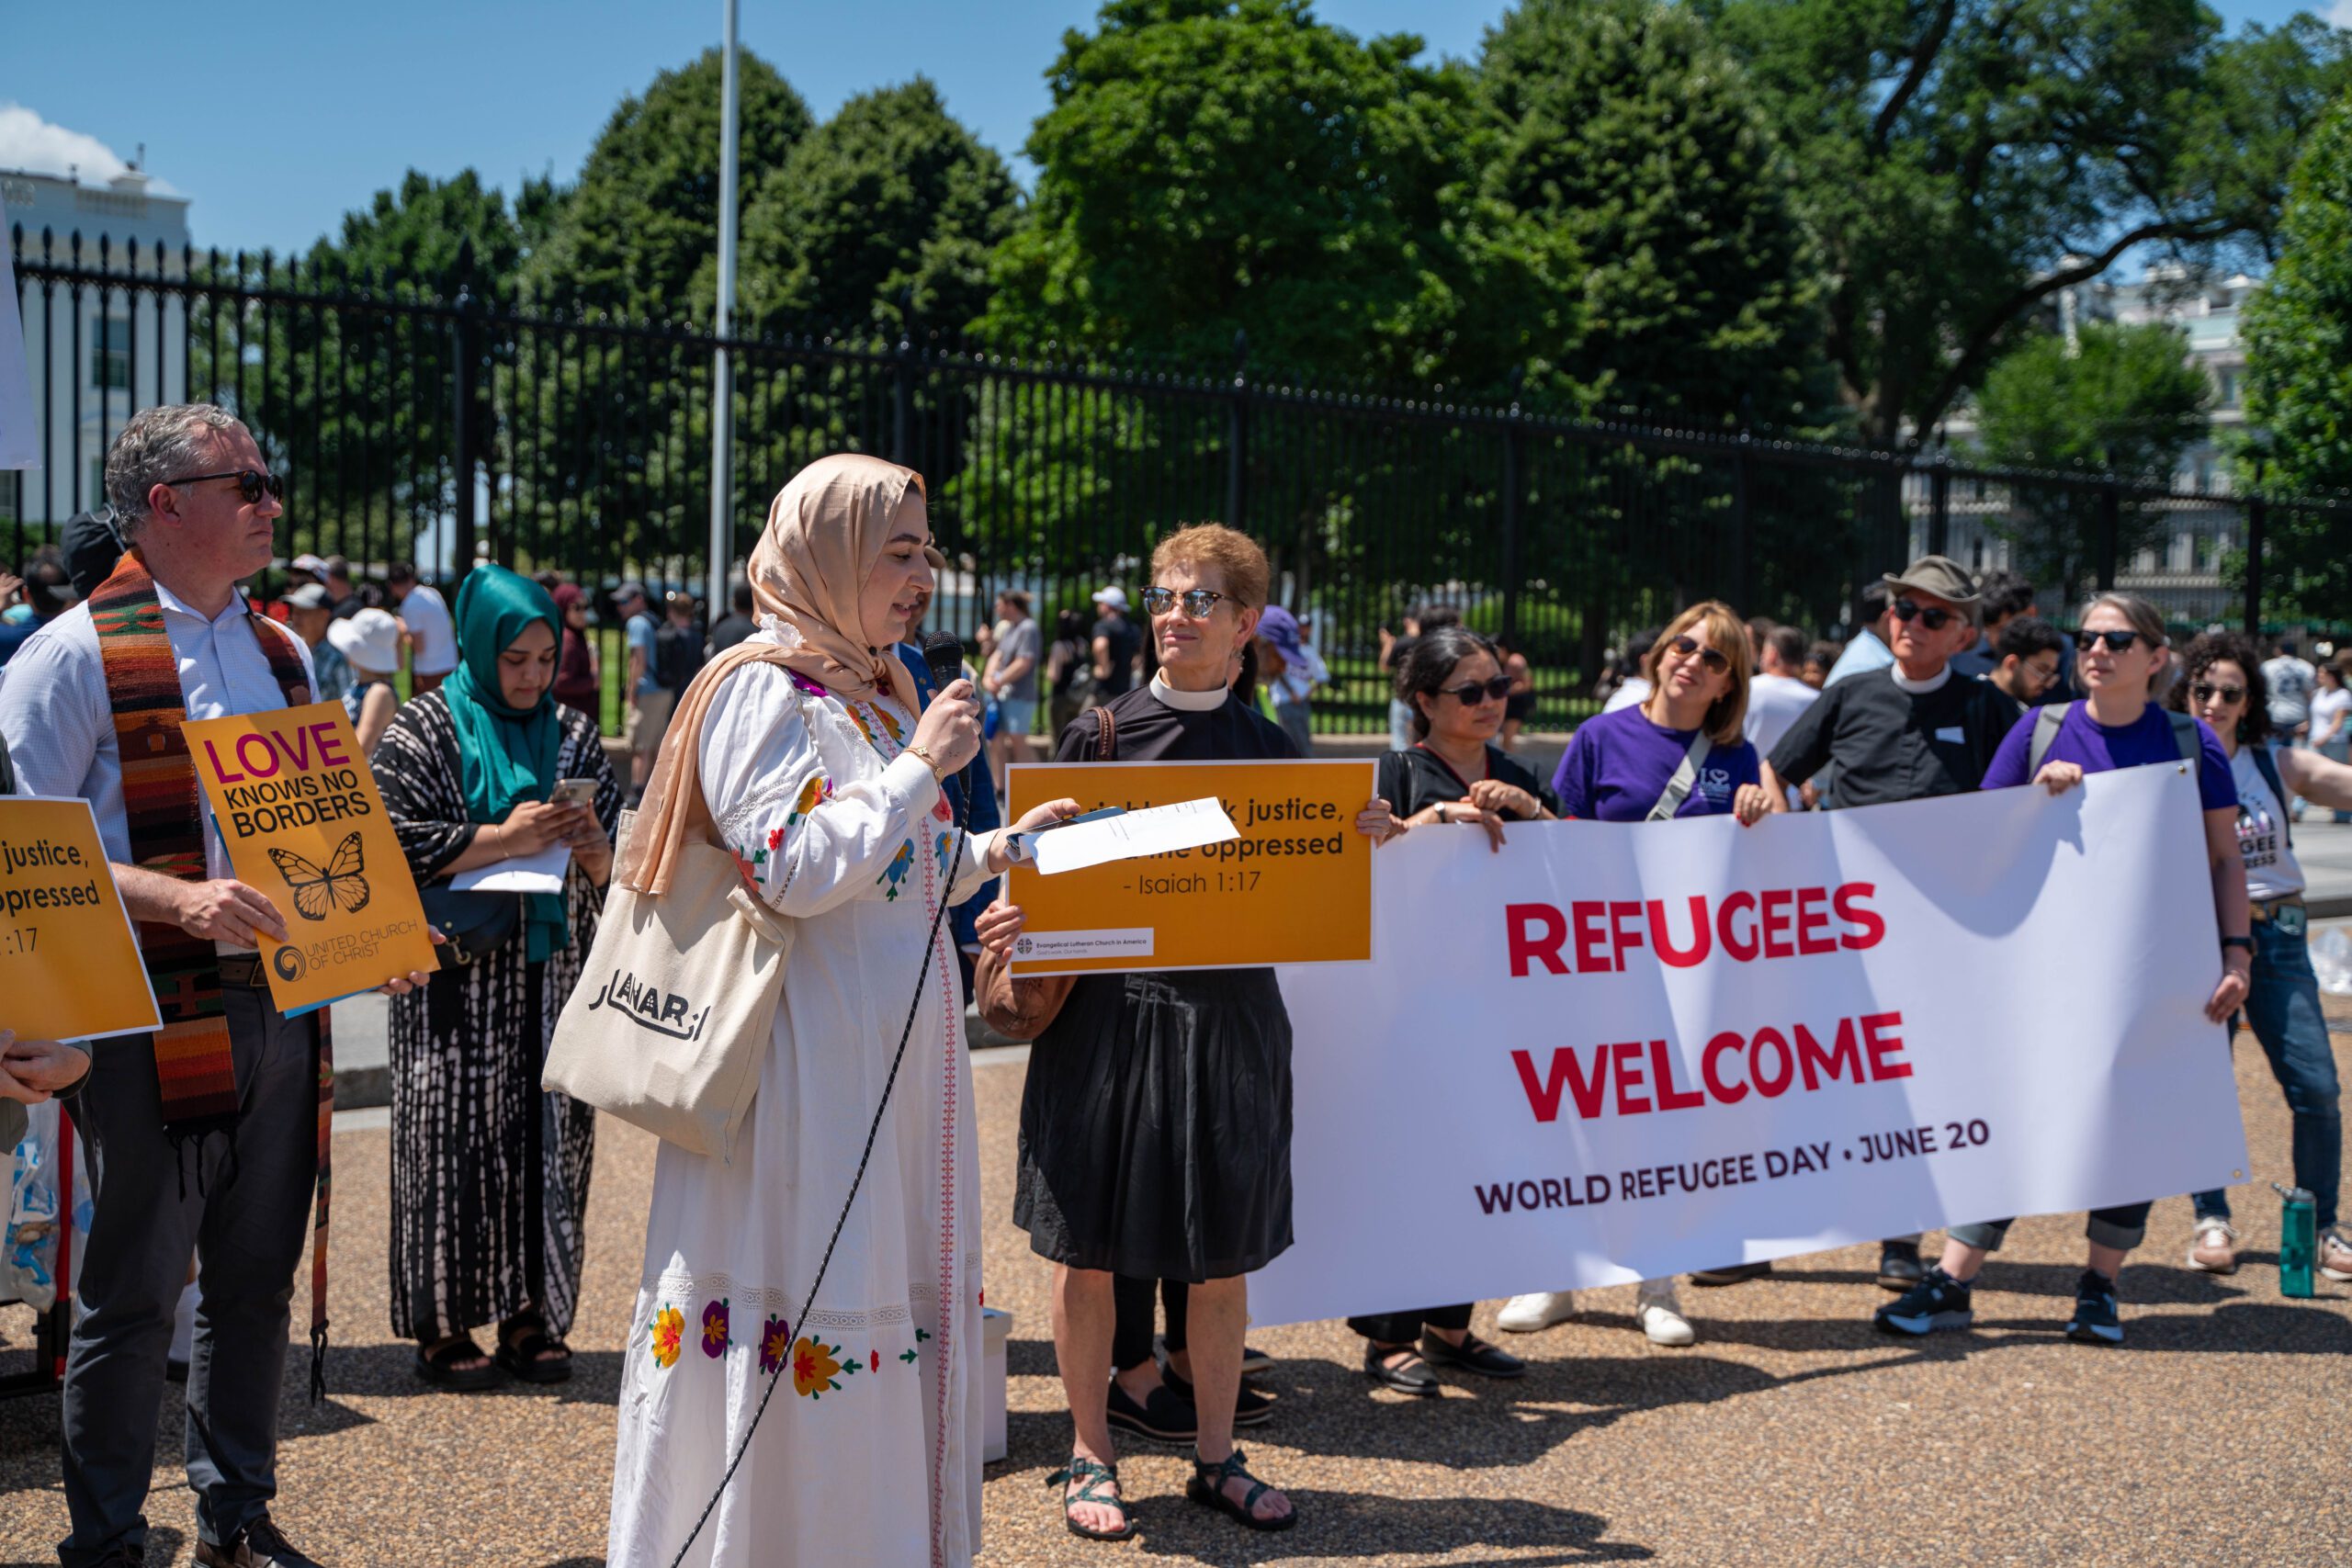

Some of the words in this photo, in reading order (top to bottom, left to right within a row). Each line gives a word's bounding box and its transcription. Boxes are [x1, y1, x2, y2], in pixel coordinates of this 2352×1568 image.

[203, 721, 351, 784] LOVE
[223, 776, 320, 810] KNOWS
[321, 769, 358, 793] NO
[232, 791, 371, 839] BORDERS
[1246, 797, 1344, 828] justice,
[2, 840, 88, 874] justice,
[1201, 831, 1343, 863] oppressed
[1139, 873, 1206, 896] Isaiah
[1217, 871, 1261, 892] 1:17
[0, 927, 38, 955] :17
[305, 934, 356, 957] UNITED
[359, 919, 419, 942] CHURCH
[1036, 942, 1069, 950] Evangelical
[1506, 882, 1886, 977] REFUGEES
[310, 956, 329, 971] OF
[333, 942, 380, 964] CHRIST
[1510, 1010, 1914, 1122] WELCOME
[1475, 1175, 1611, 1214] WORLD
[1621, 1155, 1758, 1201] REFUGEE
[1764, 1142, 1831, 1179] DAY
[1859, 1126, 1939, 1165] JUNE
[1945, 1118, 1990, 1150] 20
